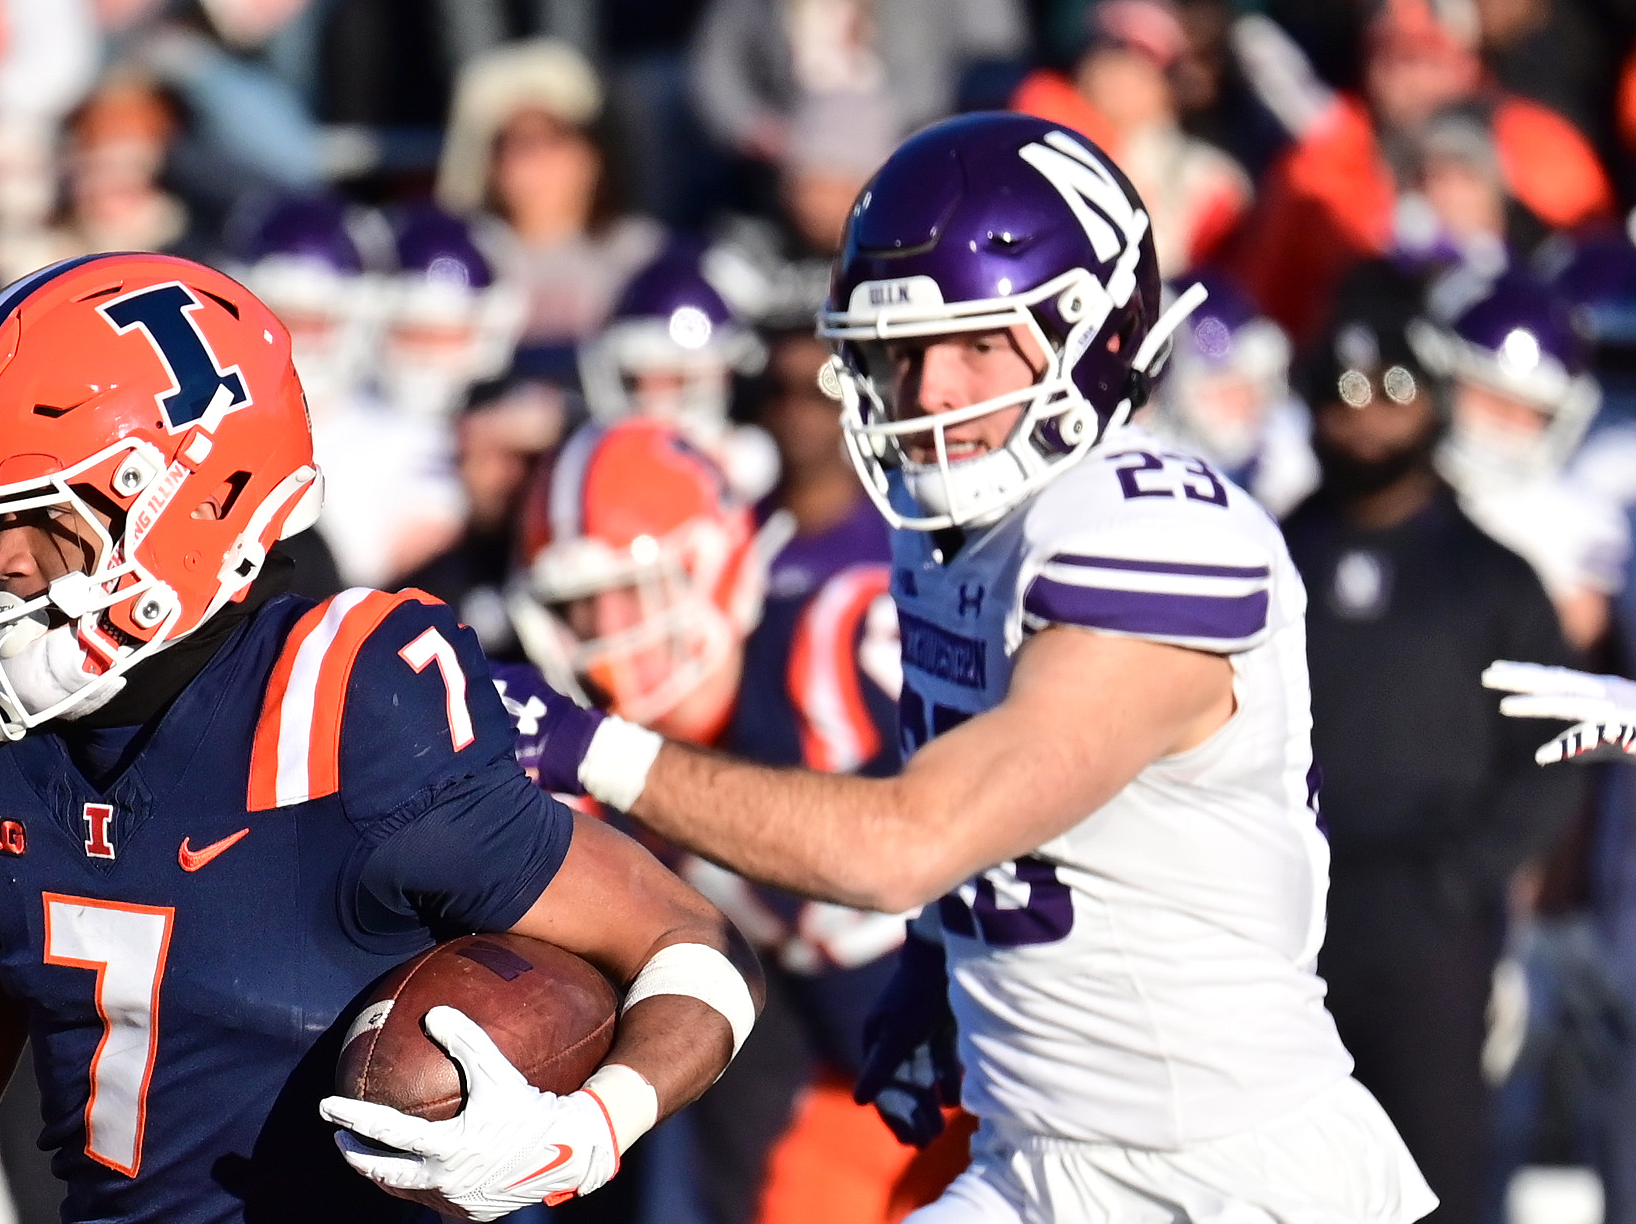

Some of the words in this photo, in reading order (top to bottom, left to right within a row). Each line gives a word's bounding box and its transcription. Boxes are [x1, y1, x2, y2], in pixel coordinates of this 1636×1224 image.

[1019, 130, 1136, 264] N
[94, 280, 254, 437] I
[147, 462, 191, 514] ILLIN
[1105, 450, 1229, 508] 23
[398, 625, 476, 754] 7
[83, 802, 116, 860] I
[42, 891, 176, 1179] 7
